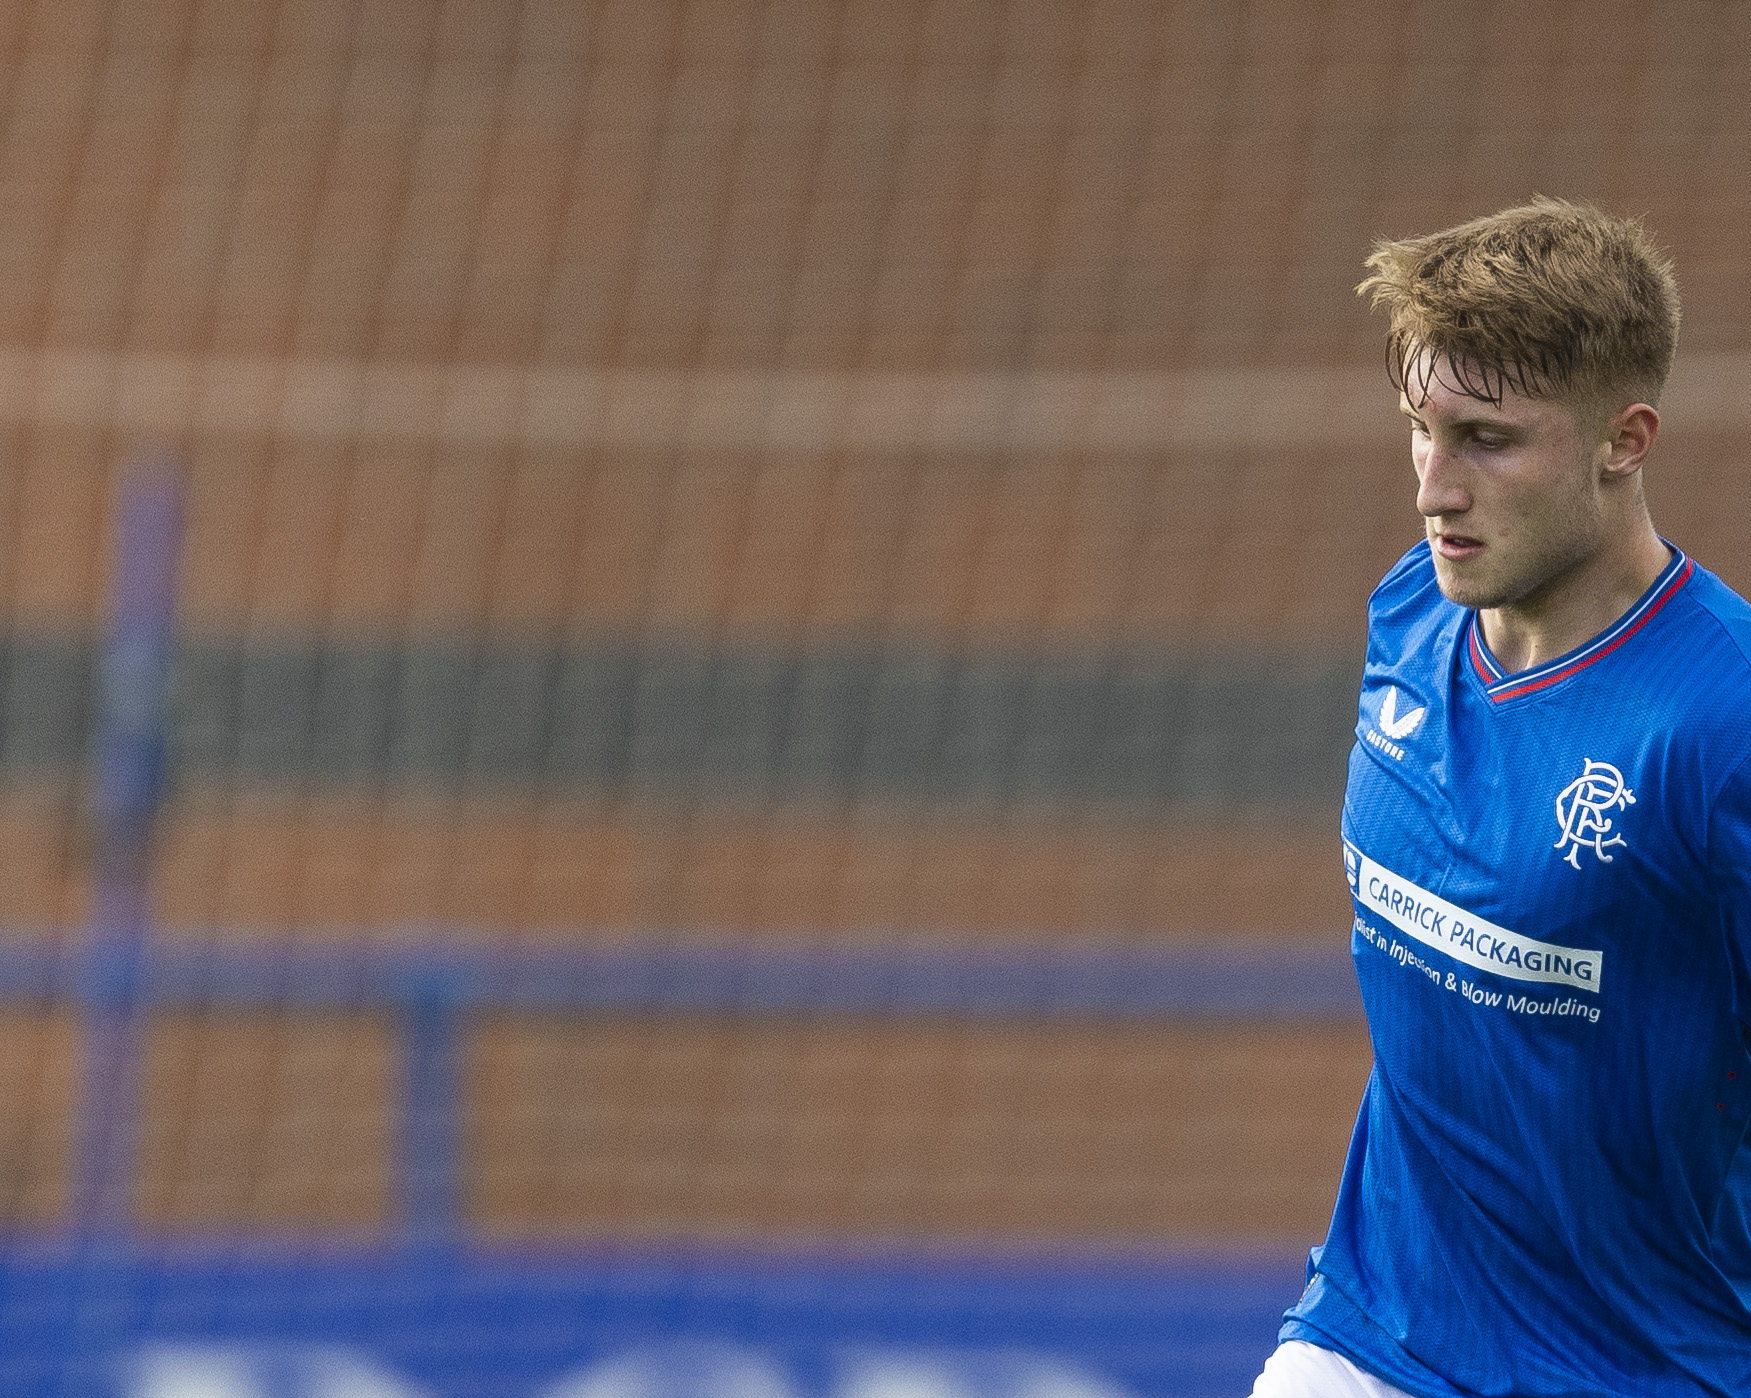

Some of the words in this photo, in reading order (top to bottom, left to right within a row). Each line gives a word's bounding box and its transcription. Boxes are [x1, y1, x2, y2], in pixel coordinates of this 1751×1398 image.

[1368, 876, 1448, 938] CARRICK
[1449, 920, 1593, 981] PACKAGING
[1377, 931, 1388, 952] in
[1444, 972, 1457, 992] &
[1461, 979, 1503, 1006] Blow
[1506, 994, 1601, 1023] Moulding
